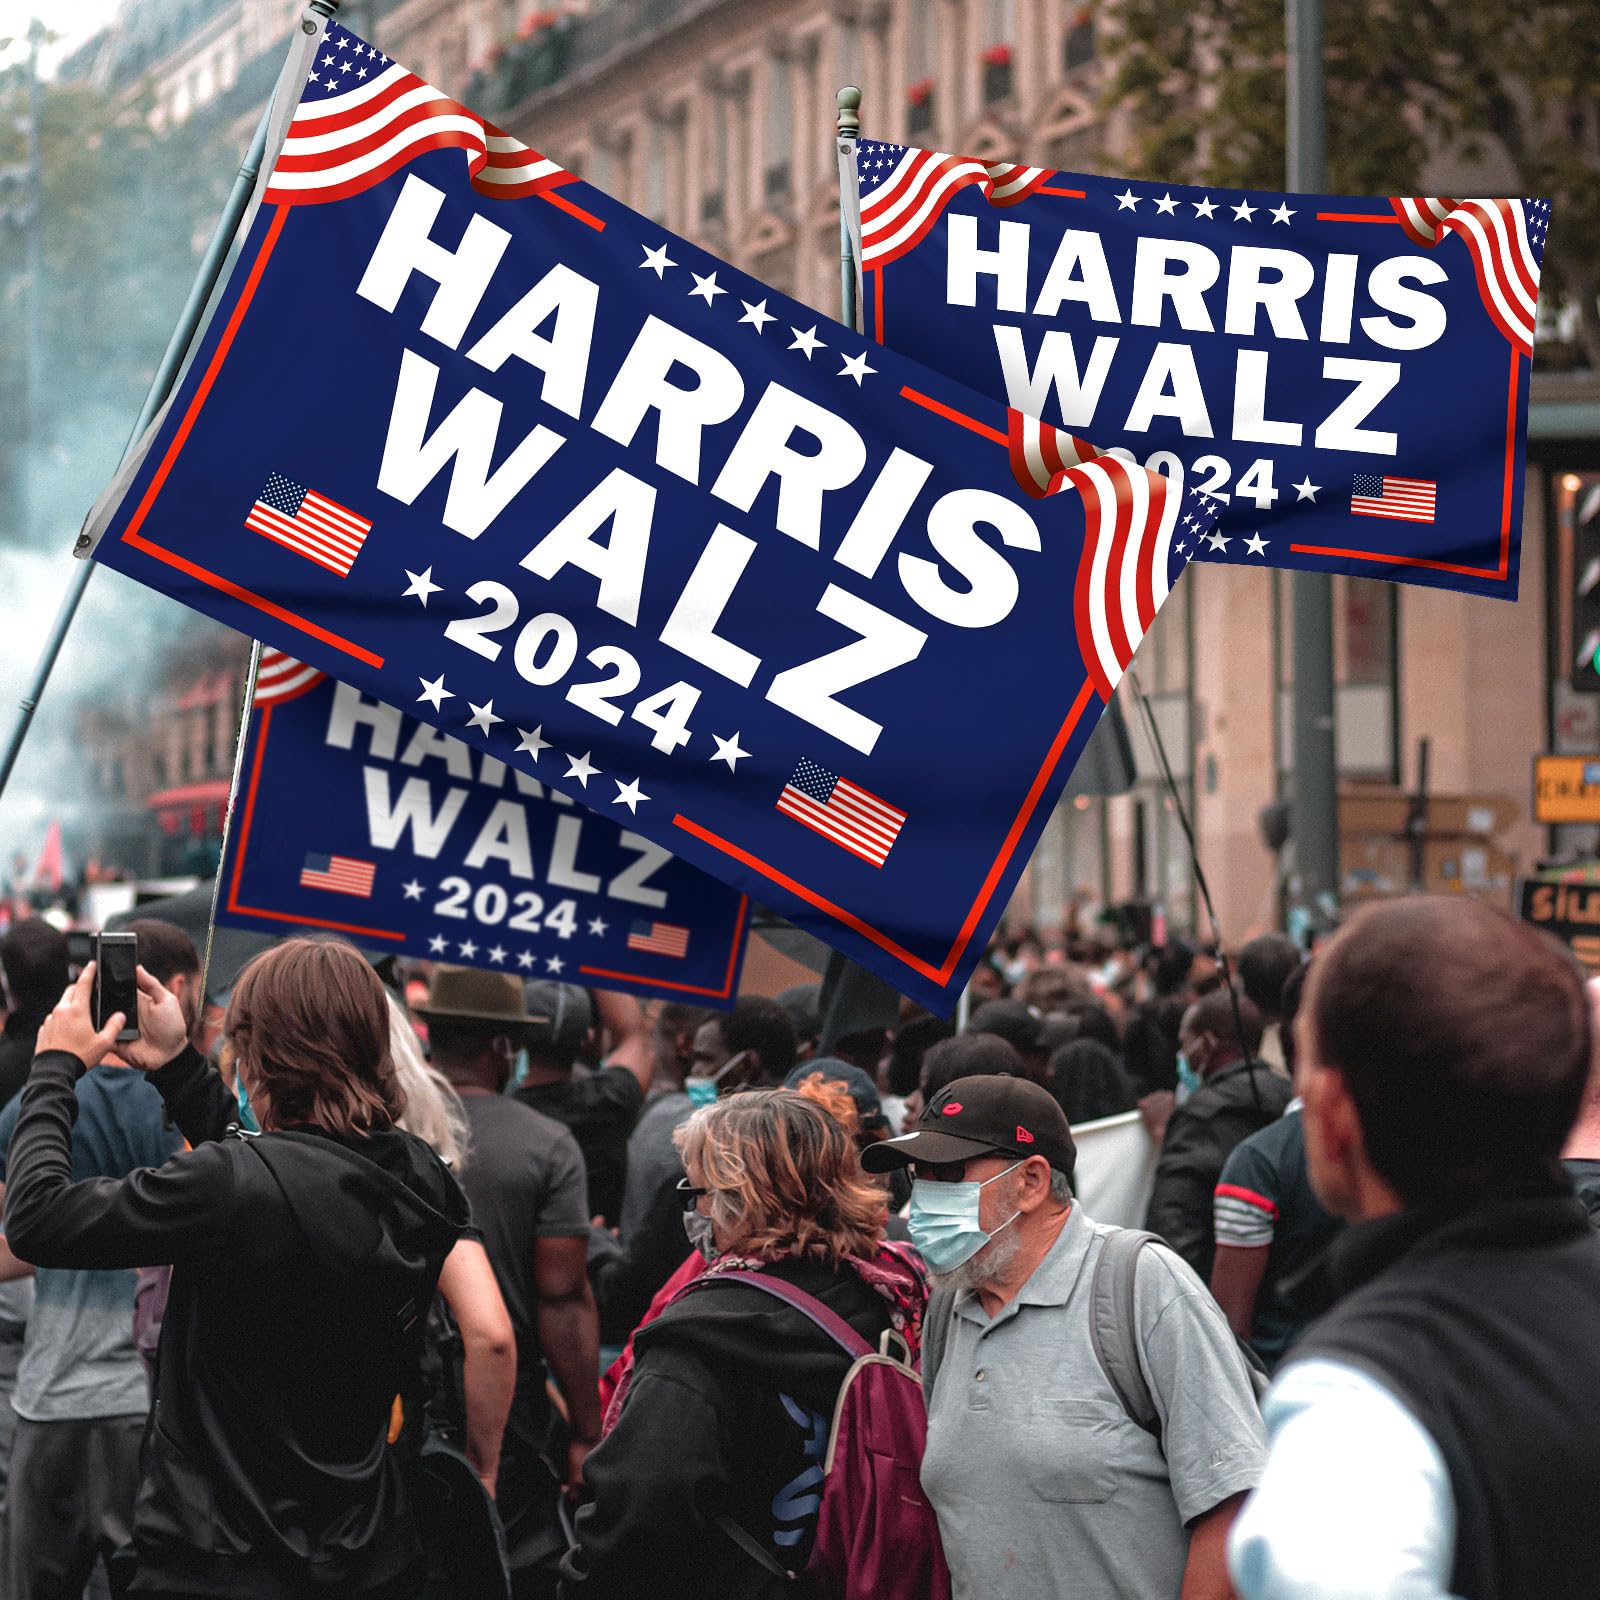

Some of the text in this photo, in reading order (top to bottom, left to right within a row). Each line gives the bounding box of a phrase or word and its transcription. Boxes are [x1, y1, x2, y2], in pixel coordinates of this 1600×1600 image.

[946, 213, 1449, 351] HARRIS
[356, 173, 1042, 628] HARRIS
[993, 325, 1401, 456] WALZ
[376, 348, 928, 755] WALZ
[443, 581, 702, 756] 2024
[363, 765, 674, 908] WALZ
[433, 876, 578, 940] 2024
